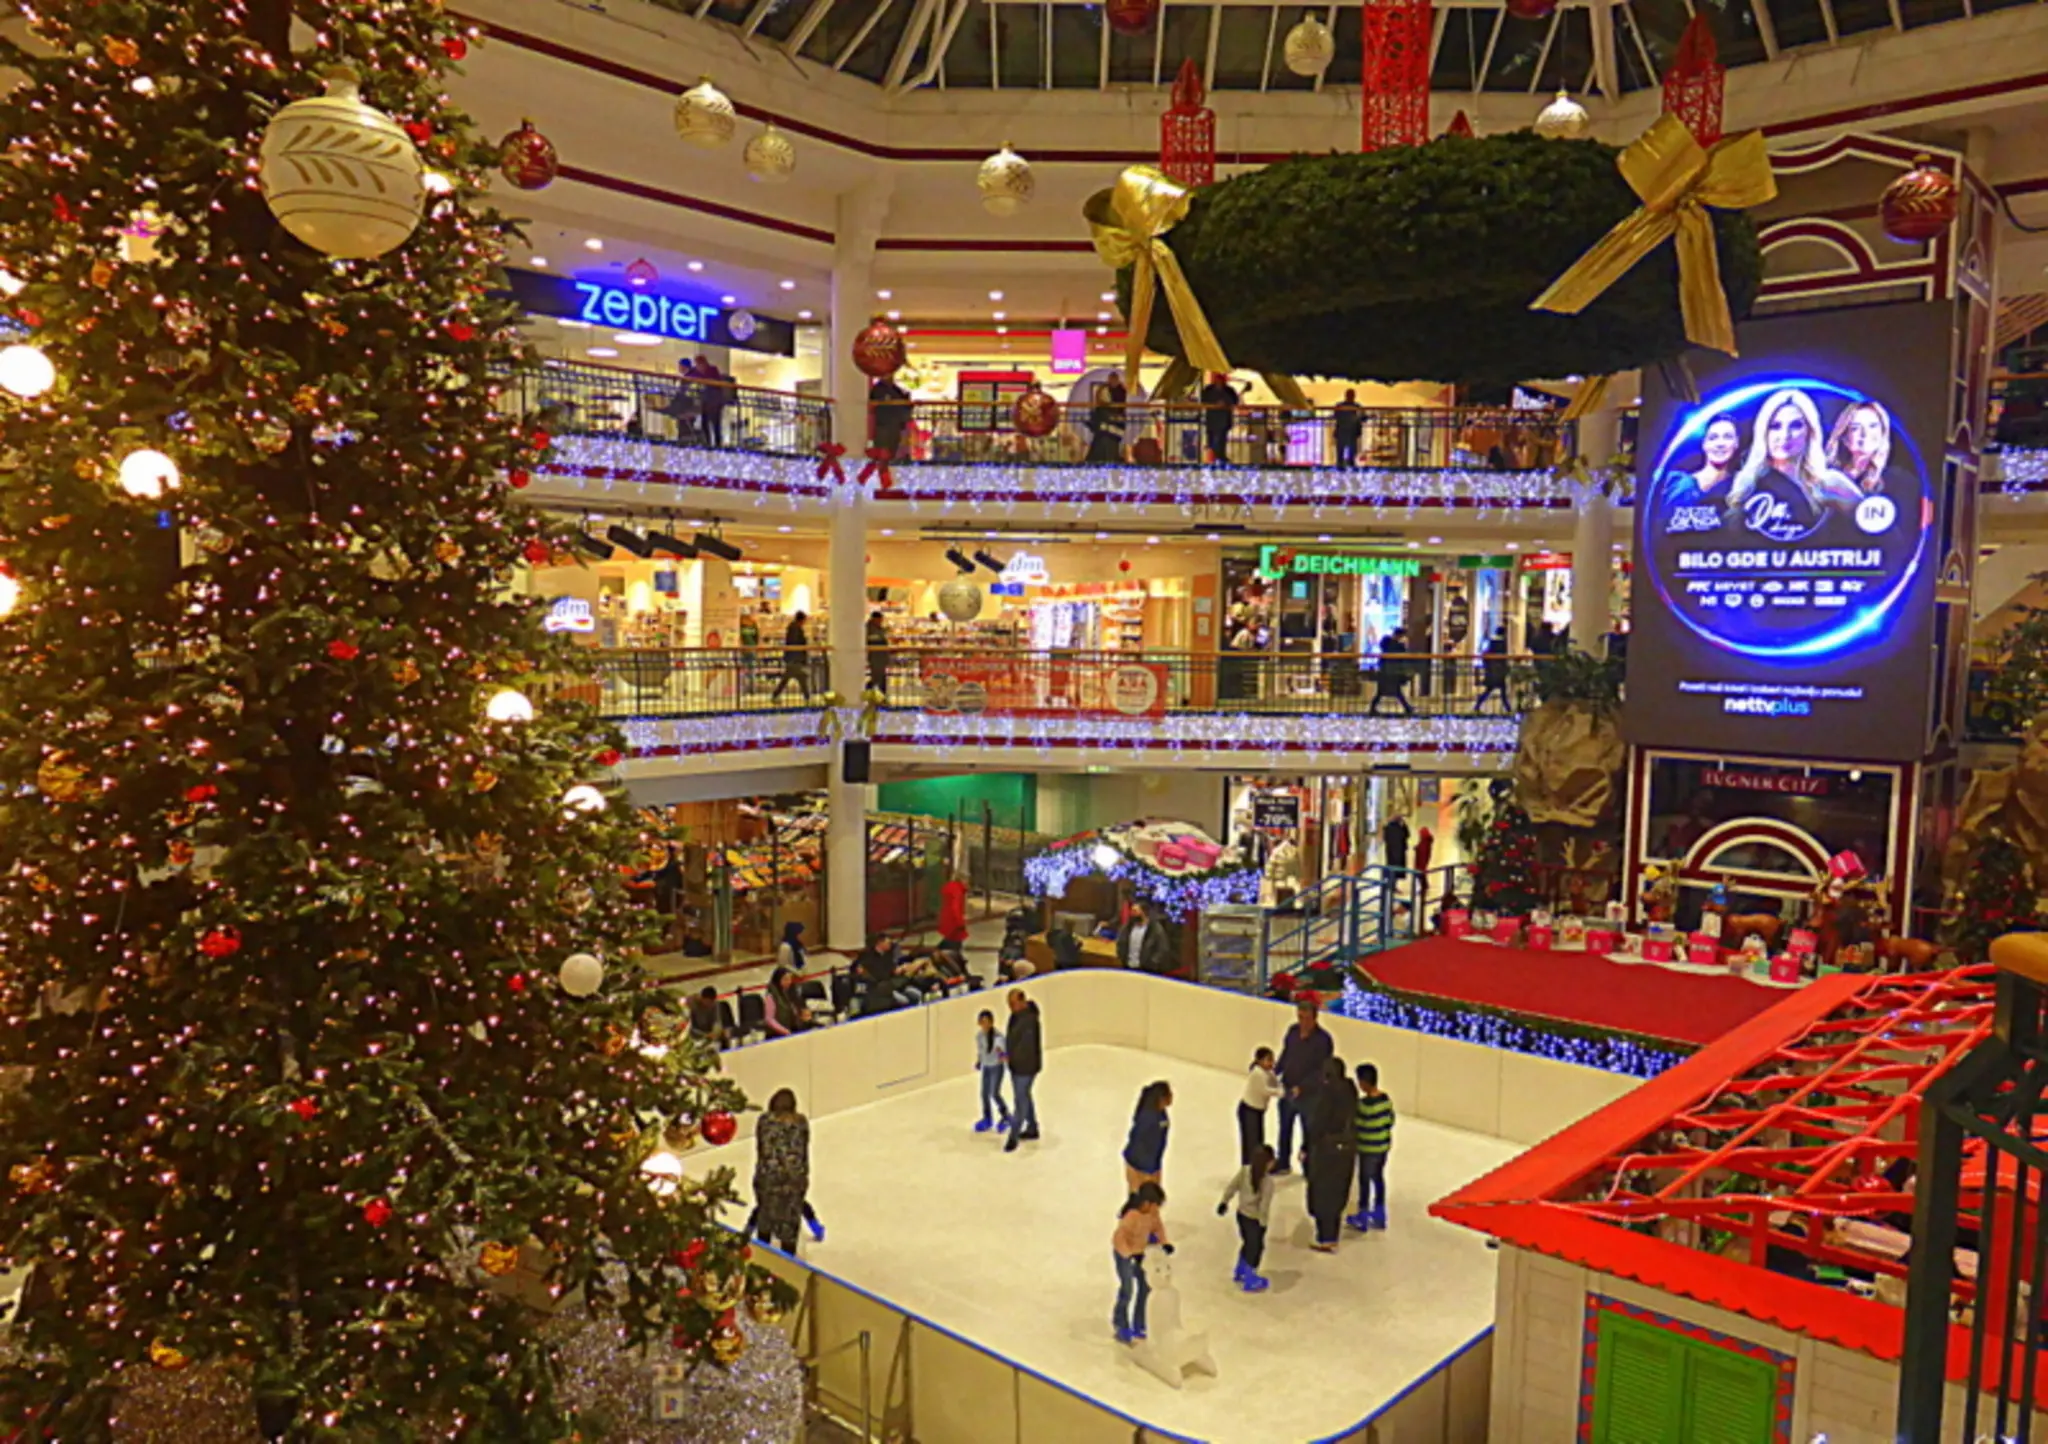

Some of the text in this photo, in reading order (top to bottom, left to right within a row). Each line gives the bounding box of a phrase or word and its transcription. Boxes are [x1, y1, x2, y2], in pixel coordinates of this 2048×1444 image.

[576, 281, 718, 341] zepter
[1864, 506, 1886, 519] IN
[1294, 554, 1420, 578] DEICHMANN
[1679, 552, 1723, 570] BILO
[1726, 552, 1768, 568] GDE
[1771, 551, 1786, 567] U
